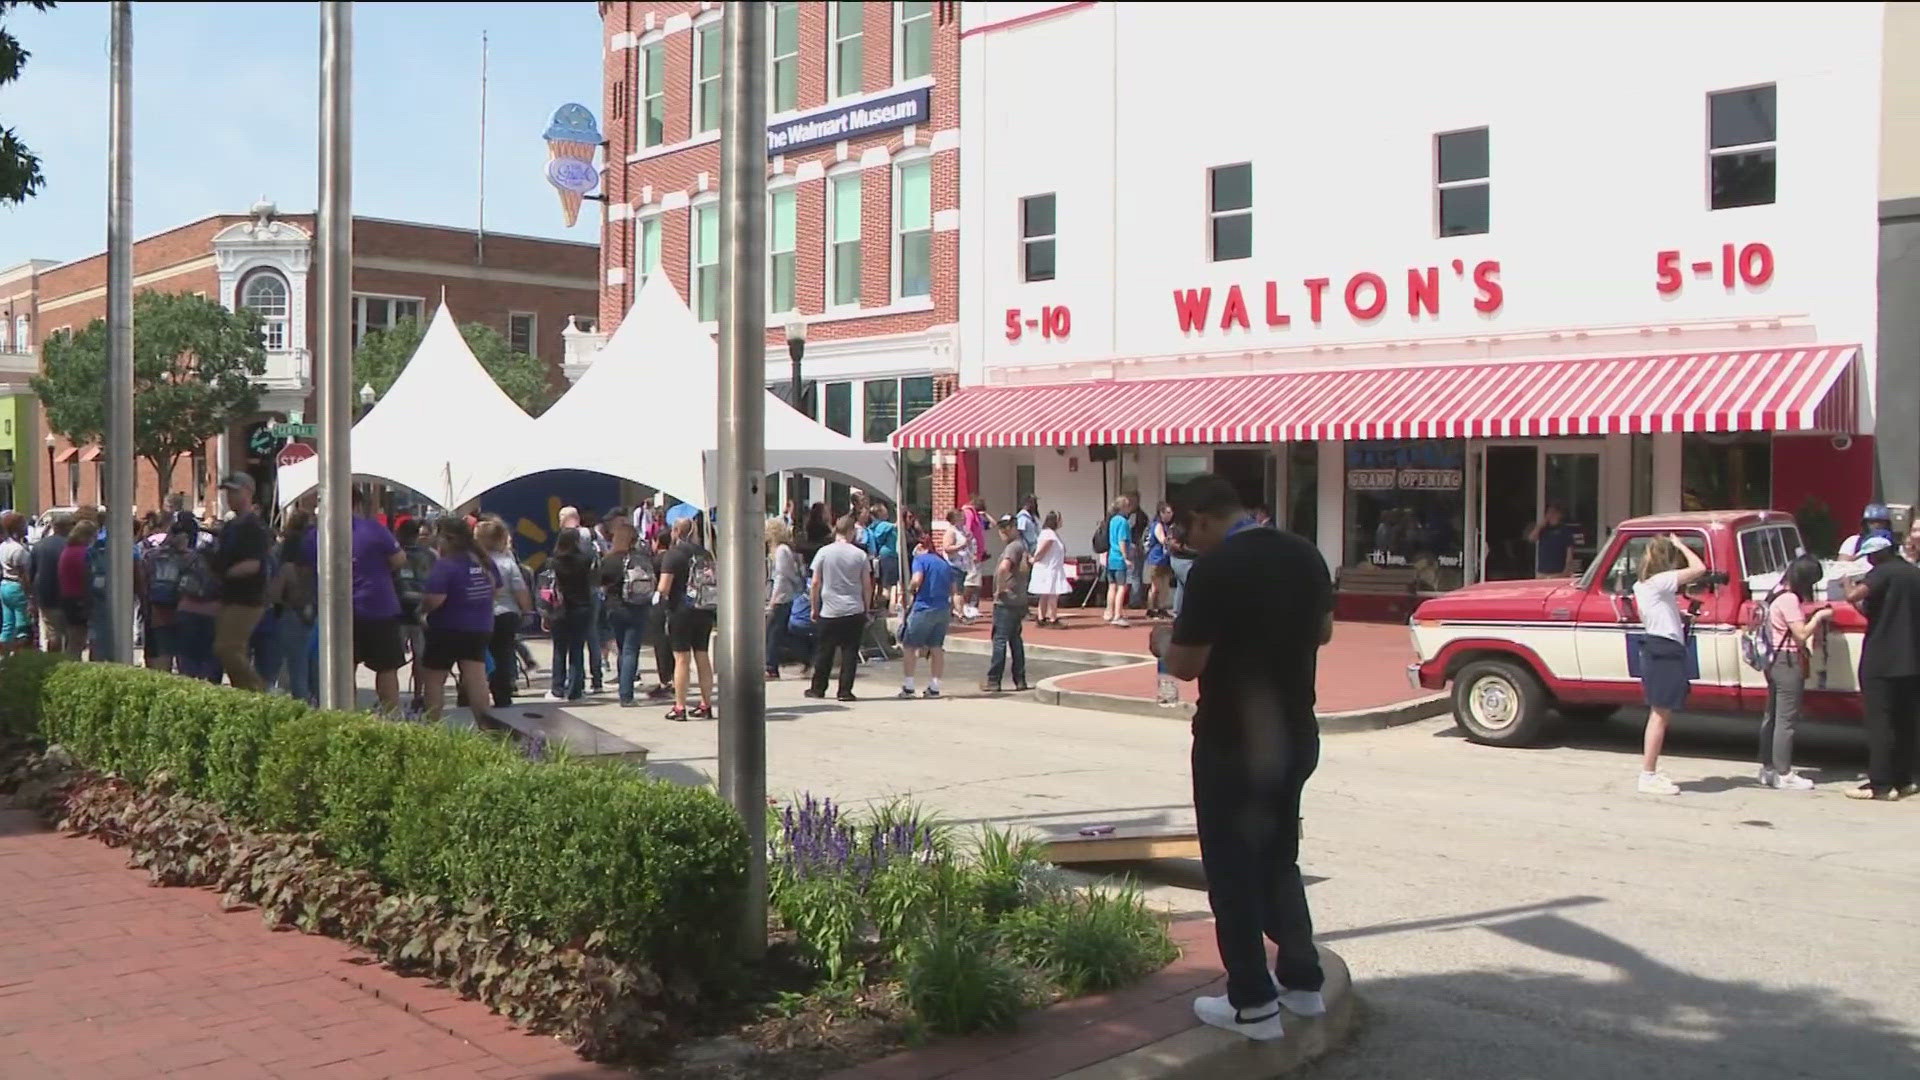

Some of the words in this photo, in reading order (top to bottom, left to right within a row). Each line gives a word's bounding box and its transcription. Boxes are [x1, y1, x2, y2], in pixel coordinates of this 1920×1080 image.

[788, 113, 848, 144] Walmart
[850, 99, 917, 130] Museum
[1656, 242, 1775, 296] 5-10
[1173, 258, 1504, 333] WALTON'S
[1006, 305, 1071, 338] 5-10
[1351, 473, 1394, 487] GRAND
[1401, 472, 1461, 487] OPENING
